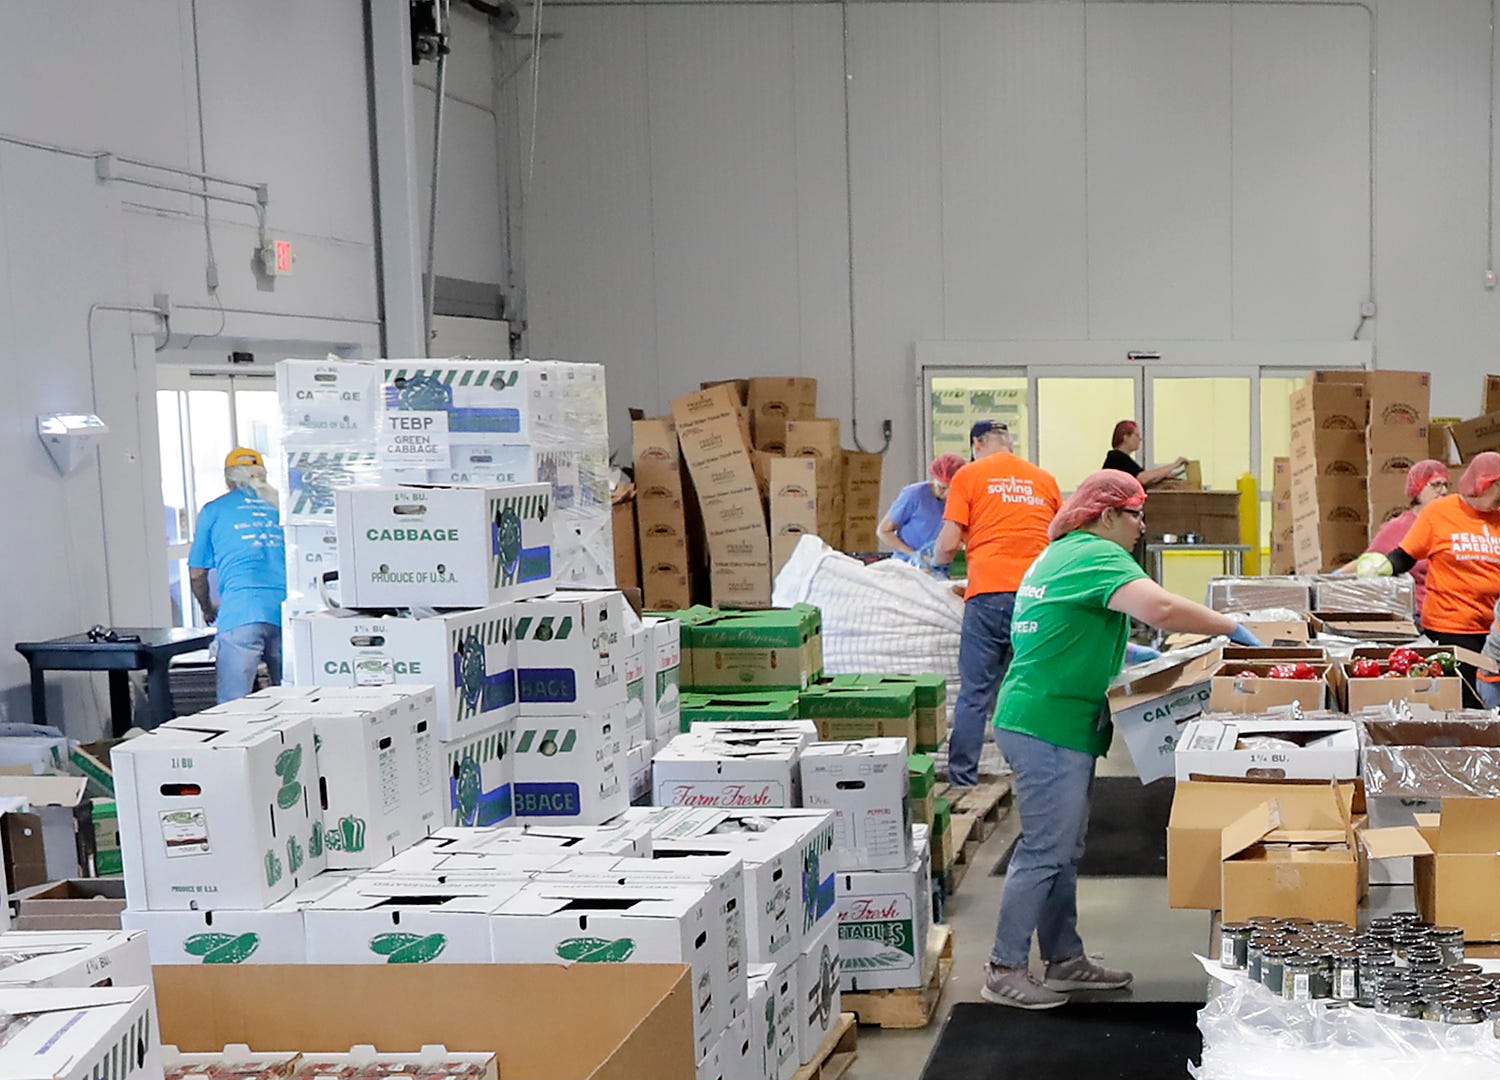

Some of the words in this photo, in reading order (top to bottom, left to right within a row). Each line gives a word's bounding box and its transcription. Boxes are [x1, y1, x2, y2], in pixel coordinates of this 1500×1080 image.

[389, 417, 433, 431] TEBP
[395, 436, 431, 445] GREEN
[387, 444, 439, 454] CABBAGE
[988, 482, 1033, 495] solving
[366, 529, 459, 542] CABBAGE
[371, 572, 415, 584] PRODUCE
[416, 572, 428, 583] OF
[324, 660, 422, 675] CAGE
[672, 784, 720, 806] Farm
[721, 784, 772, 806] Fresh
[515, 793, 575, 811] BBAGE
[851, 899, 900, 921] Fresh
